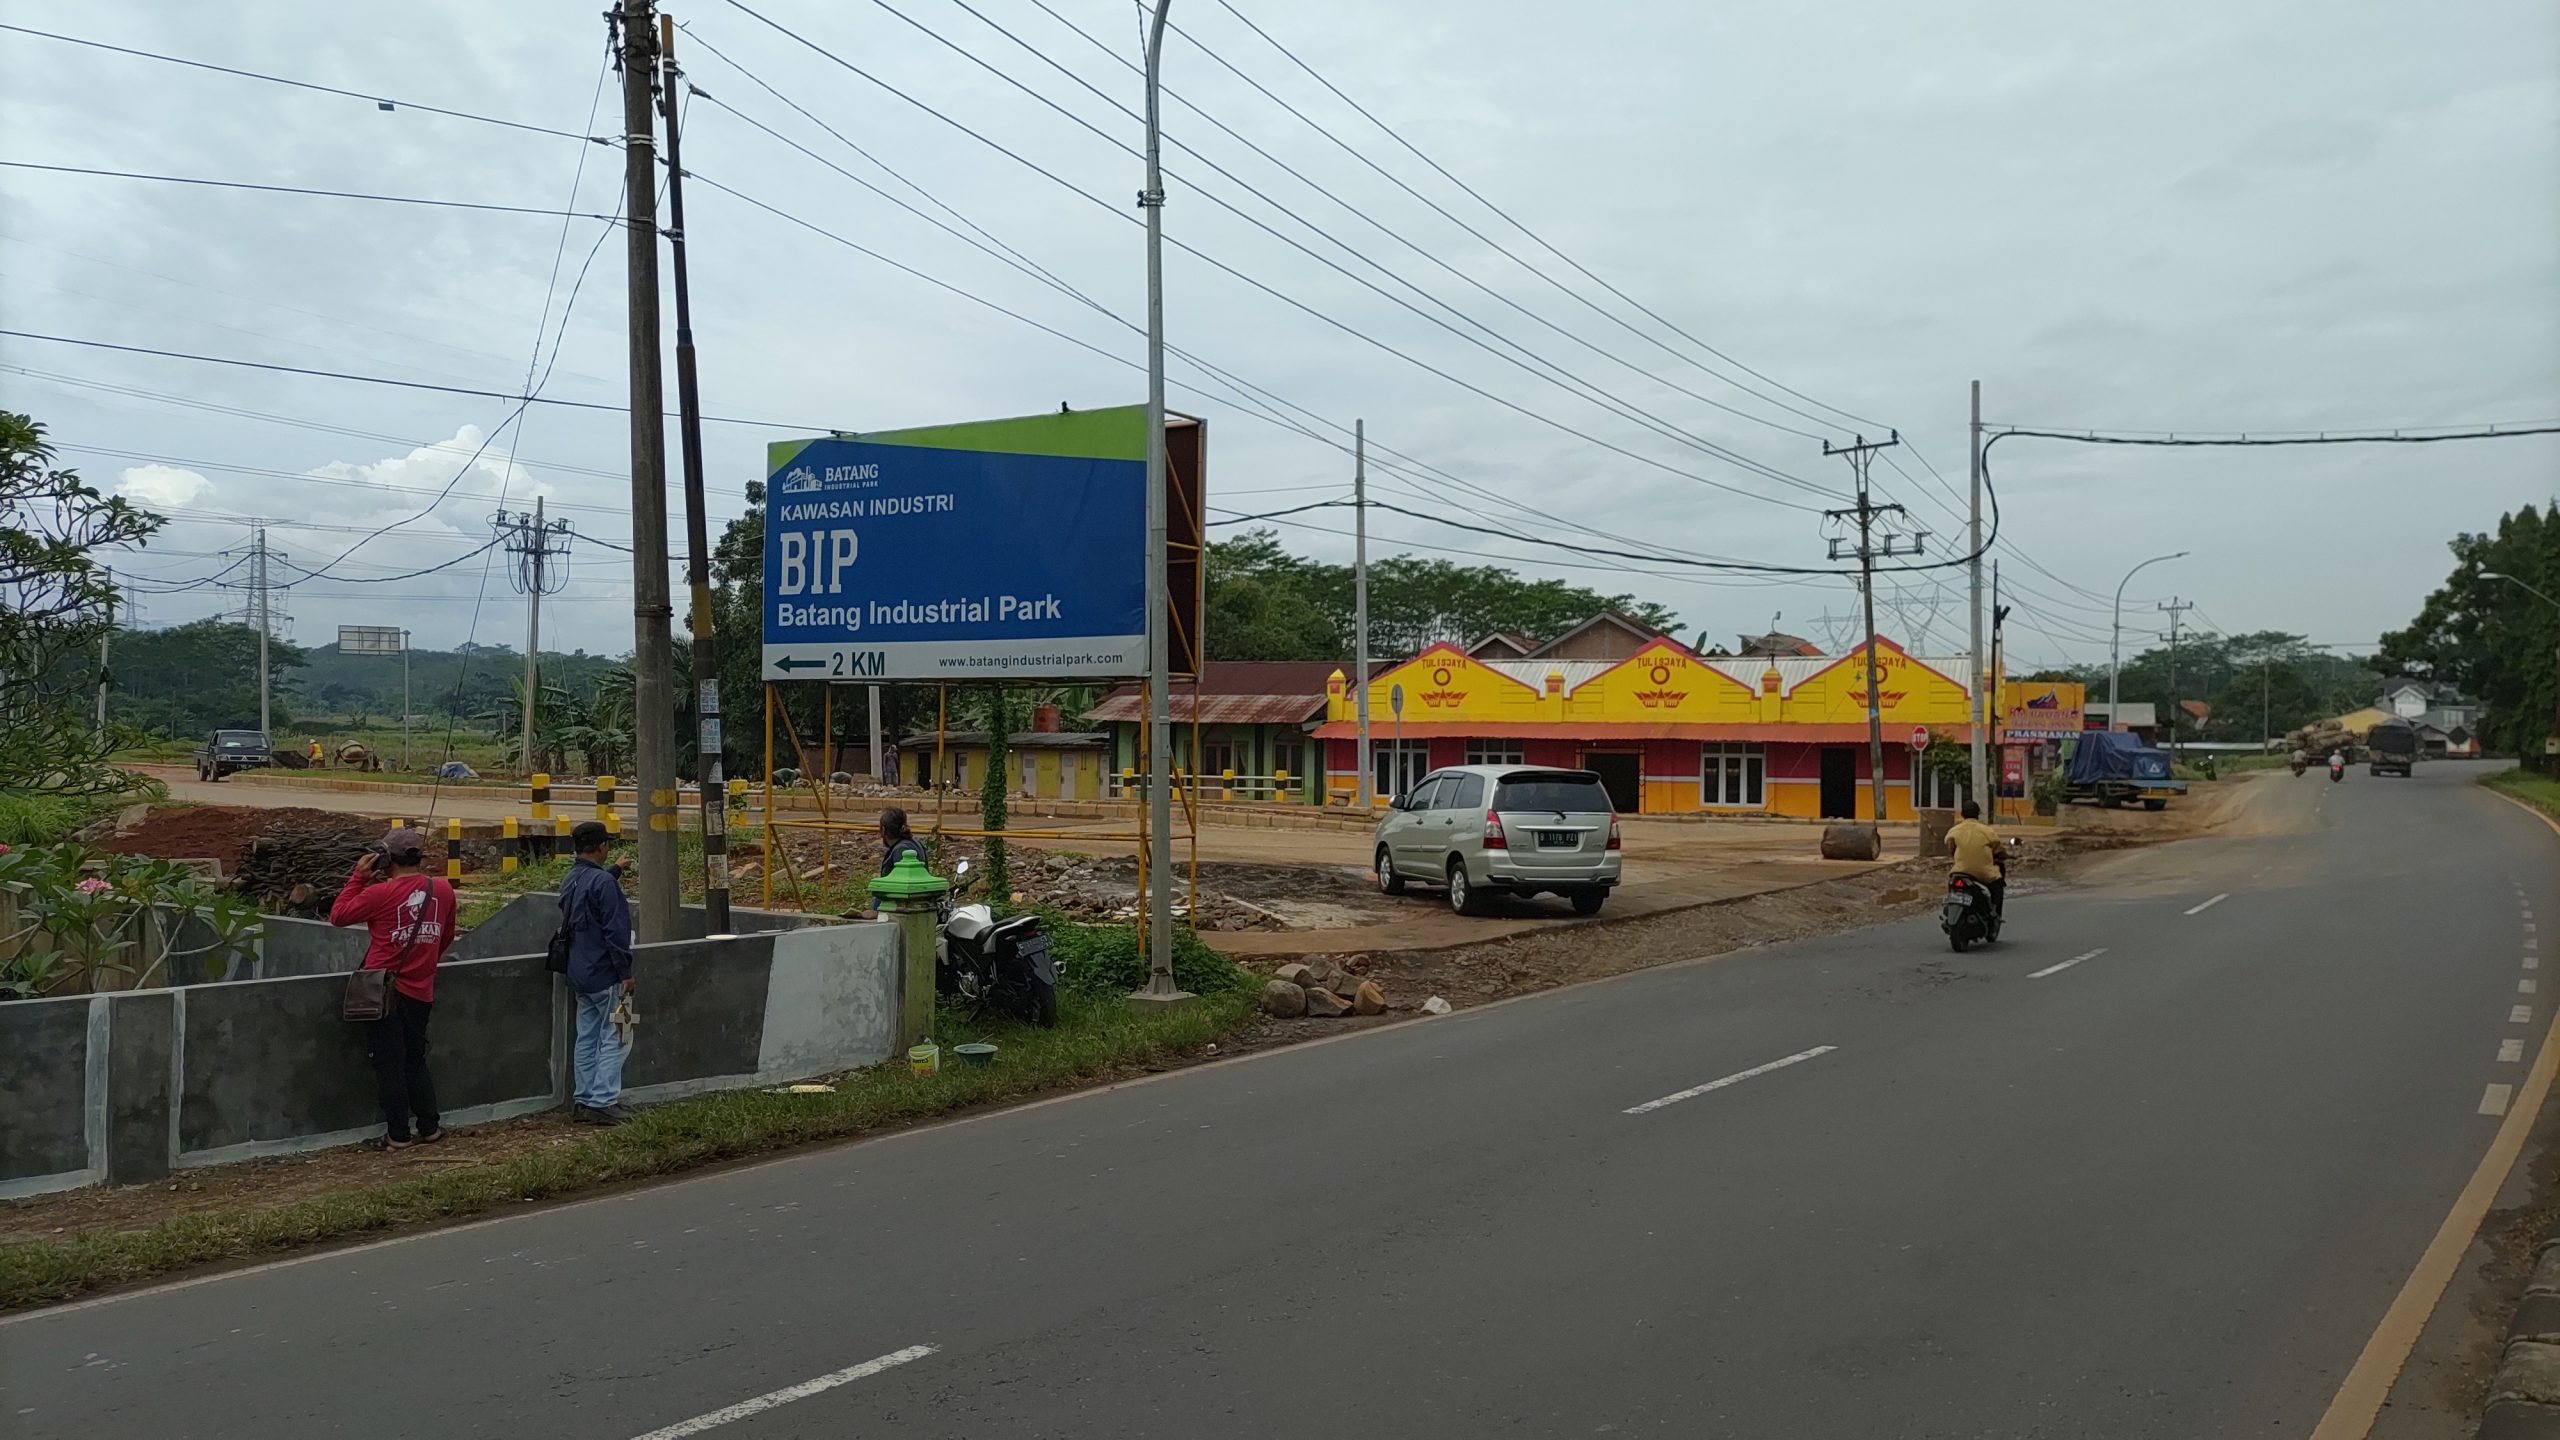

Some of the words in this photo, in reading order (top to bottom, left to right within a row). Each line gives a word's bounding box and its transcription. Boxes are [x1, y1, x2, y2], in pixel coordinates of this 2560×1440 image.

[824, 463, 879, 482] BATANG
[824, 481, 860, 491] INDUSTRIAL
[862, 480, 879, 488] PARK
[780, 500, 865, 522] KAWASAN
[869, 494, 954, 516] INDUSTRI
[778, 528, 858, 596] BIP
[778, 603, 861, 631] Batang
[869, 596, 990, 625] Industrial
[999, 593, 1062, 622] Park
[832, 651, 844, 676] 2
[851, 651, 885, 676] KM
[938, 653, 1123, 669] www.batangindustrialpark.com
[1913, 732, 1928, 743] STOP
[2006, 730, 2080, 739] PRASMANAN
[390, 924, 441, 942] PASKAN
